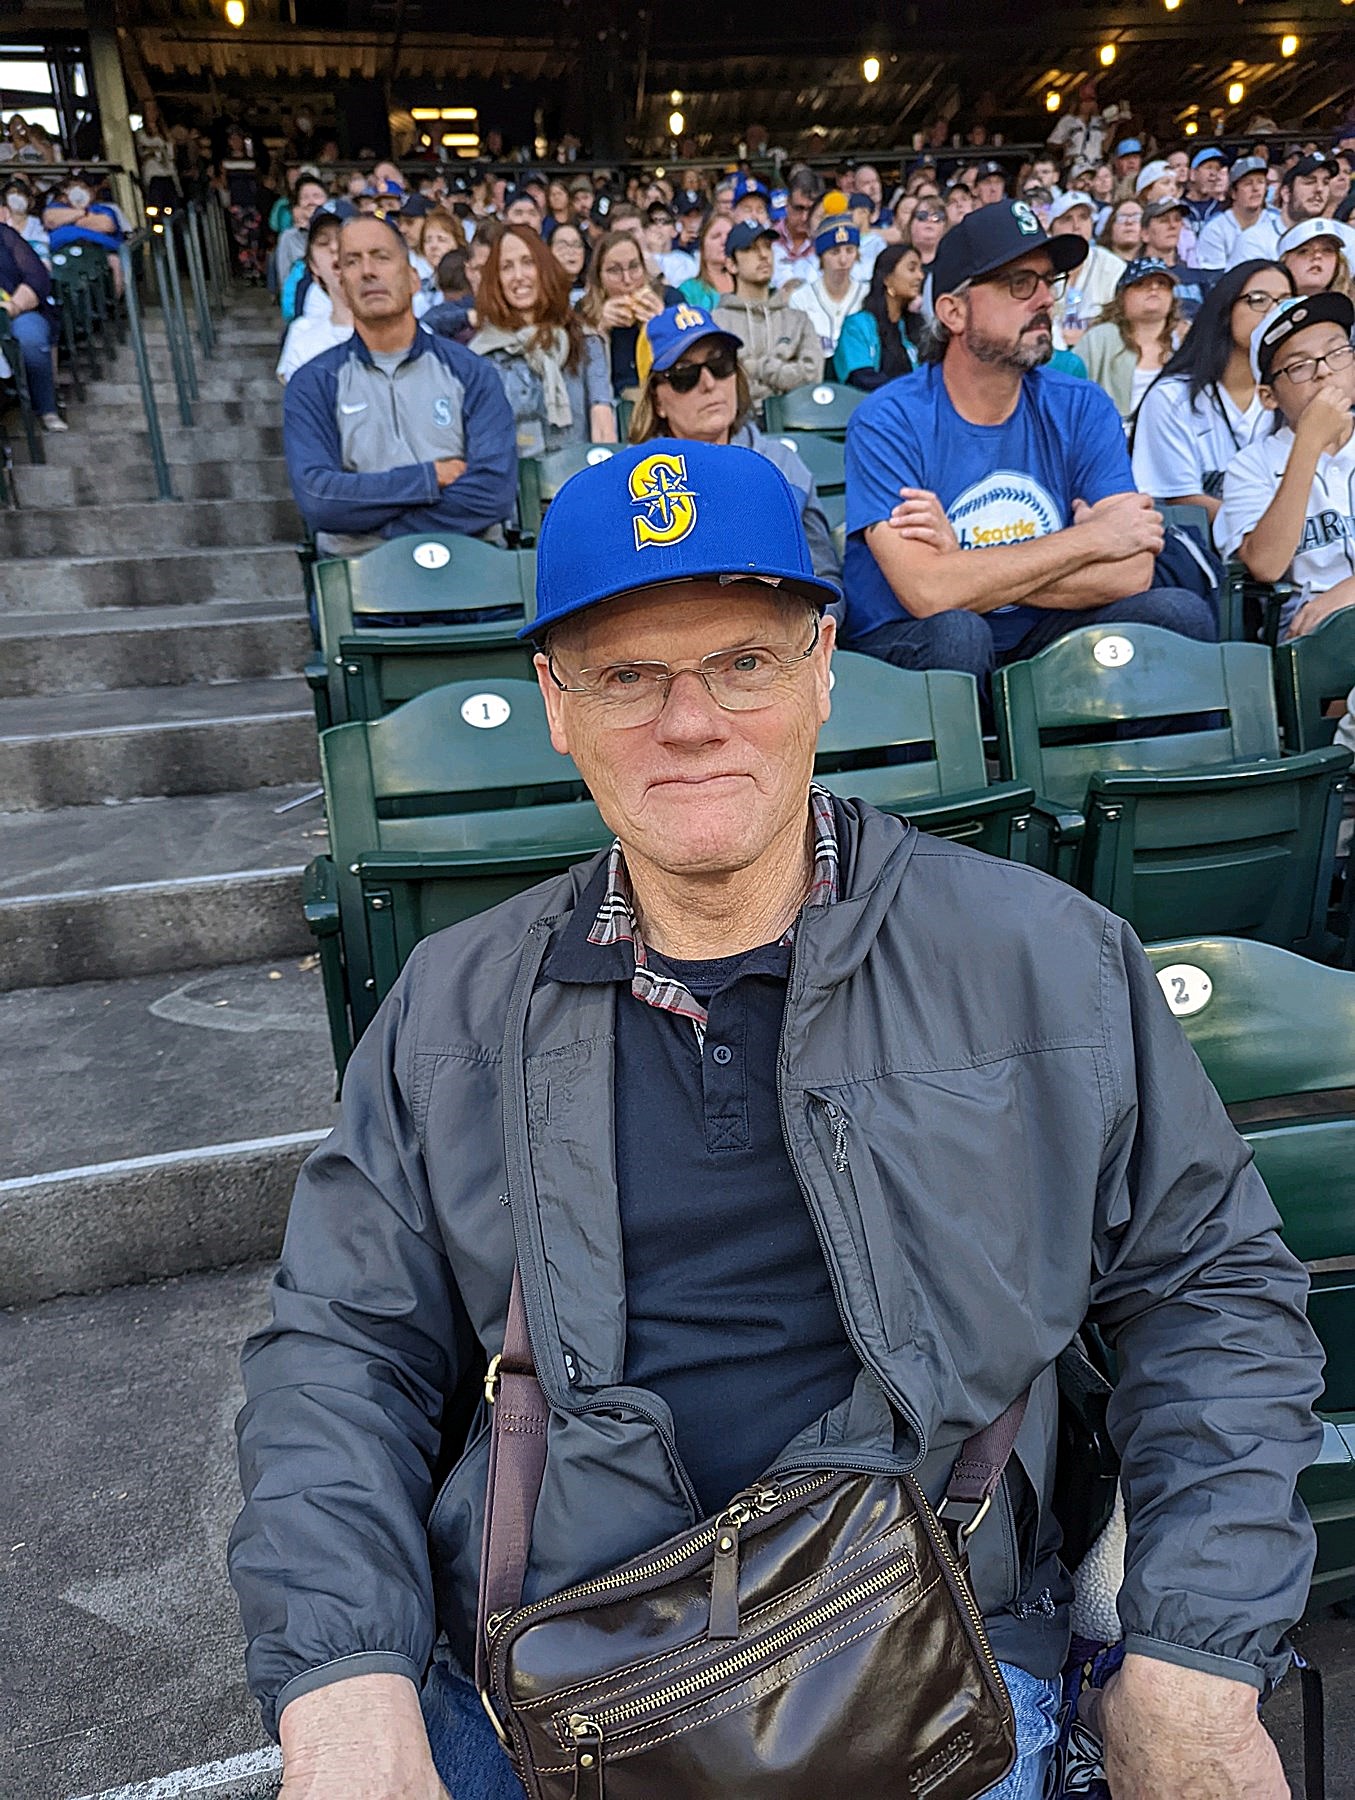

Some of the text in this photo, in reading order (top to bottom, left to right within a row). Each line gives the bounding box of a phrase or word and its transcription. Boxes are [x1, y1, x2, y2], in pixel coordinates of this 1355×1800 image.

[1011, 200, 1039, 235] S
[433, 398, 452, 427] S
[628, 453, 698, 552] S
[972, 518, 1036, 544] Seattle
[429, 549, 435, 563] 1
[1109, 644, 1118, 660] 3
[482, 703, 490, 720] 1
[1171, 977, 1189, 1004] 2
